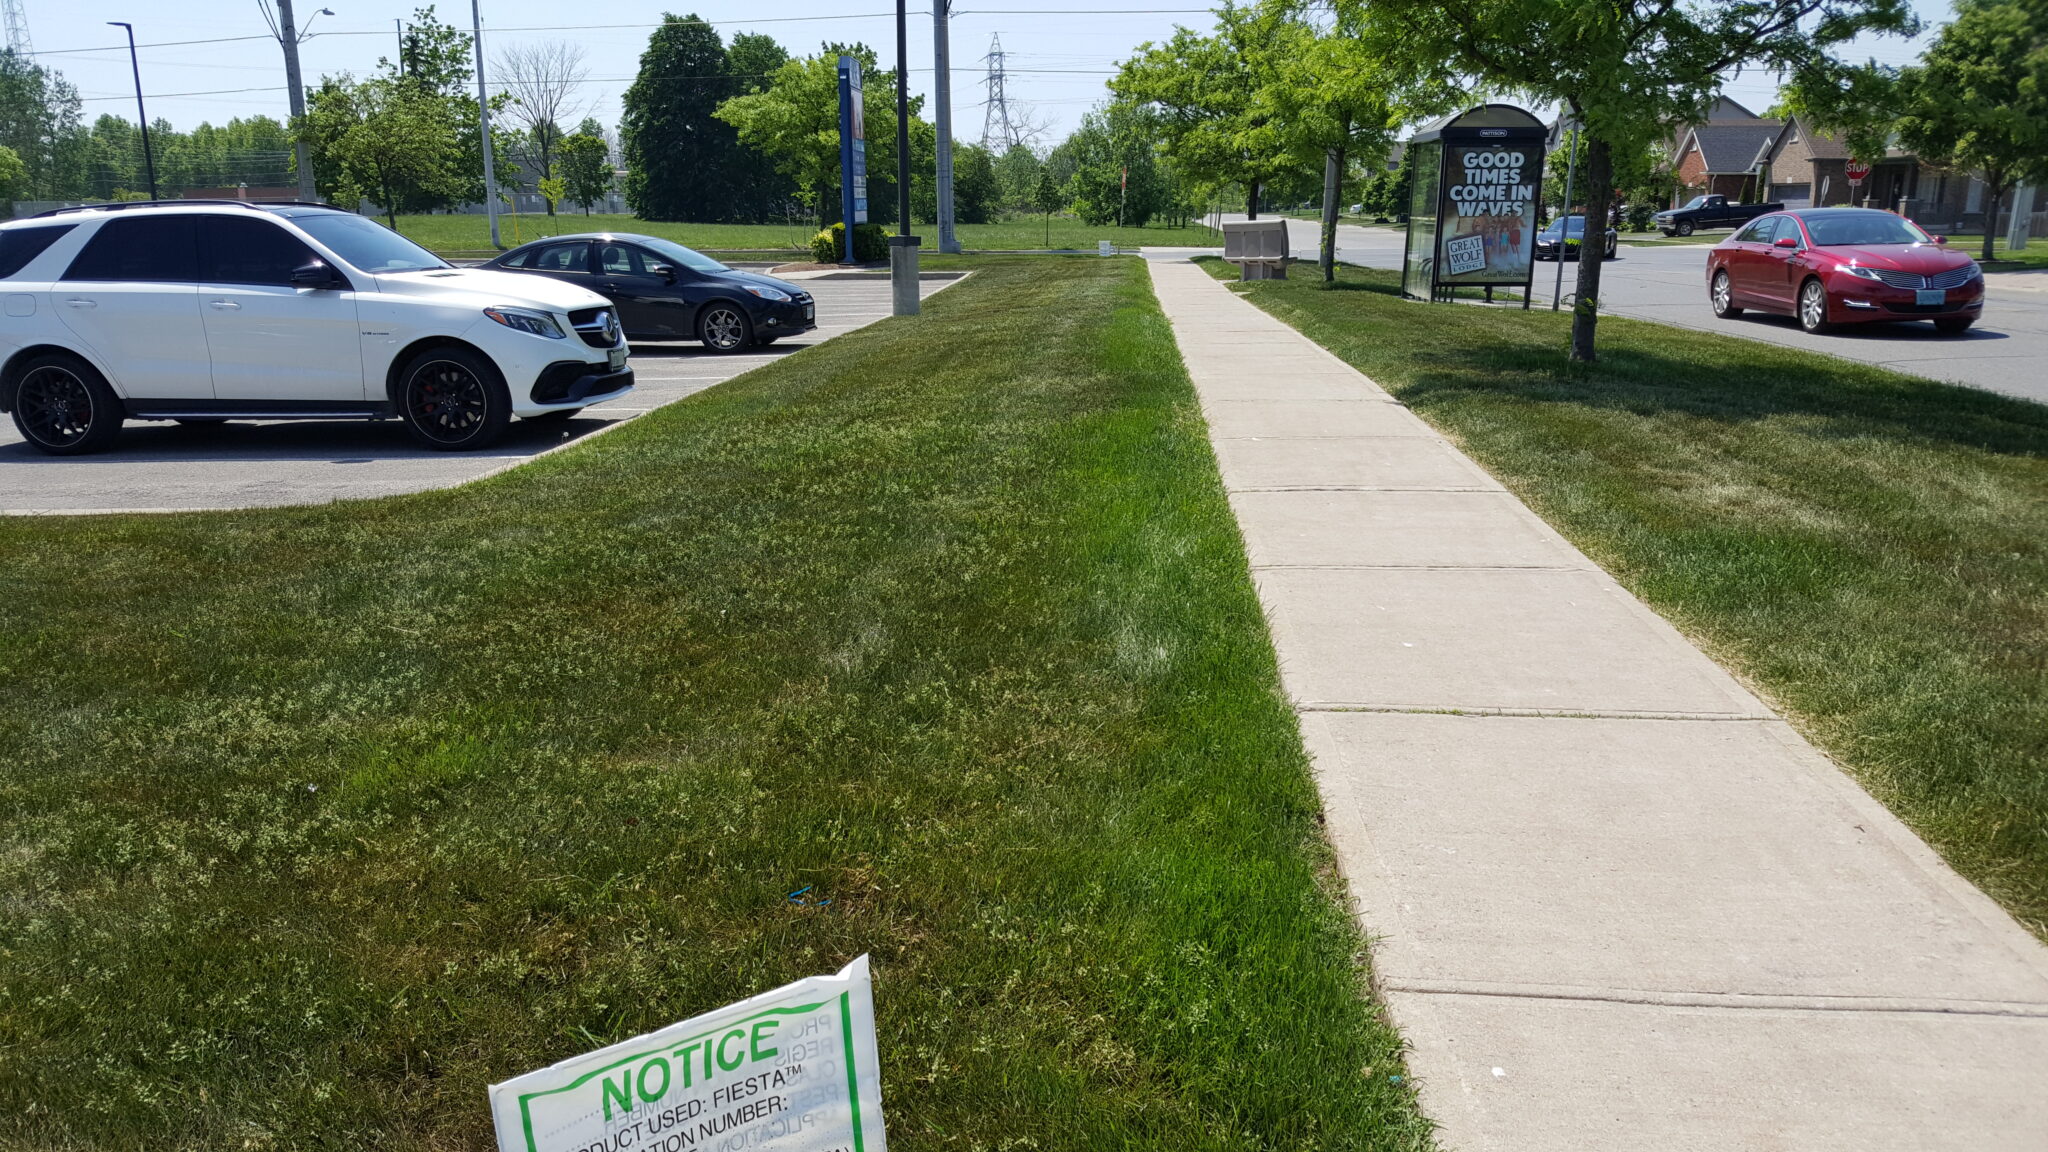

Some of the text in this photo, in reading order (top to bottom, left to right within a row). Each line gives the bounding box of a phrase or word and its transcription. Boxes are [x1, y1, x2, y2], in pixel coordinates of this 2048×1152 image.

[1463, 151, 1525, 168] GOOD
[1464, 168, 1521, 184] TIMES
[1846, 163, 1868, 173] STOP
[1449, 185, 1533, 201] COME IN
[1456, 201, 1524, 217] WAVES
[1450, 237, 1481, 253] GREAT
[1451, 248, 1482, 264] WOLF
[602, 1020, 781, 1122] NOTICE
[578, 1121, 644, 1152] DUCT
[648, 1098, 708, 1134] USED:
[713, 1063, 803, 1109] FIESTA™
[640, 1127, 695, 1152] TION
[698, 1095, 789, 1138] NUMBER:
